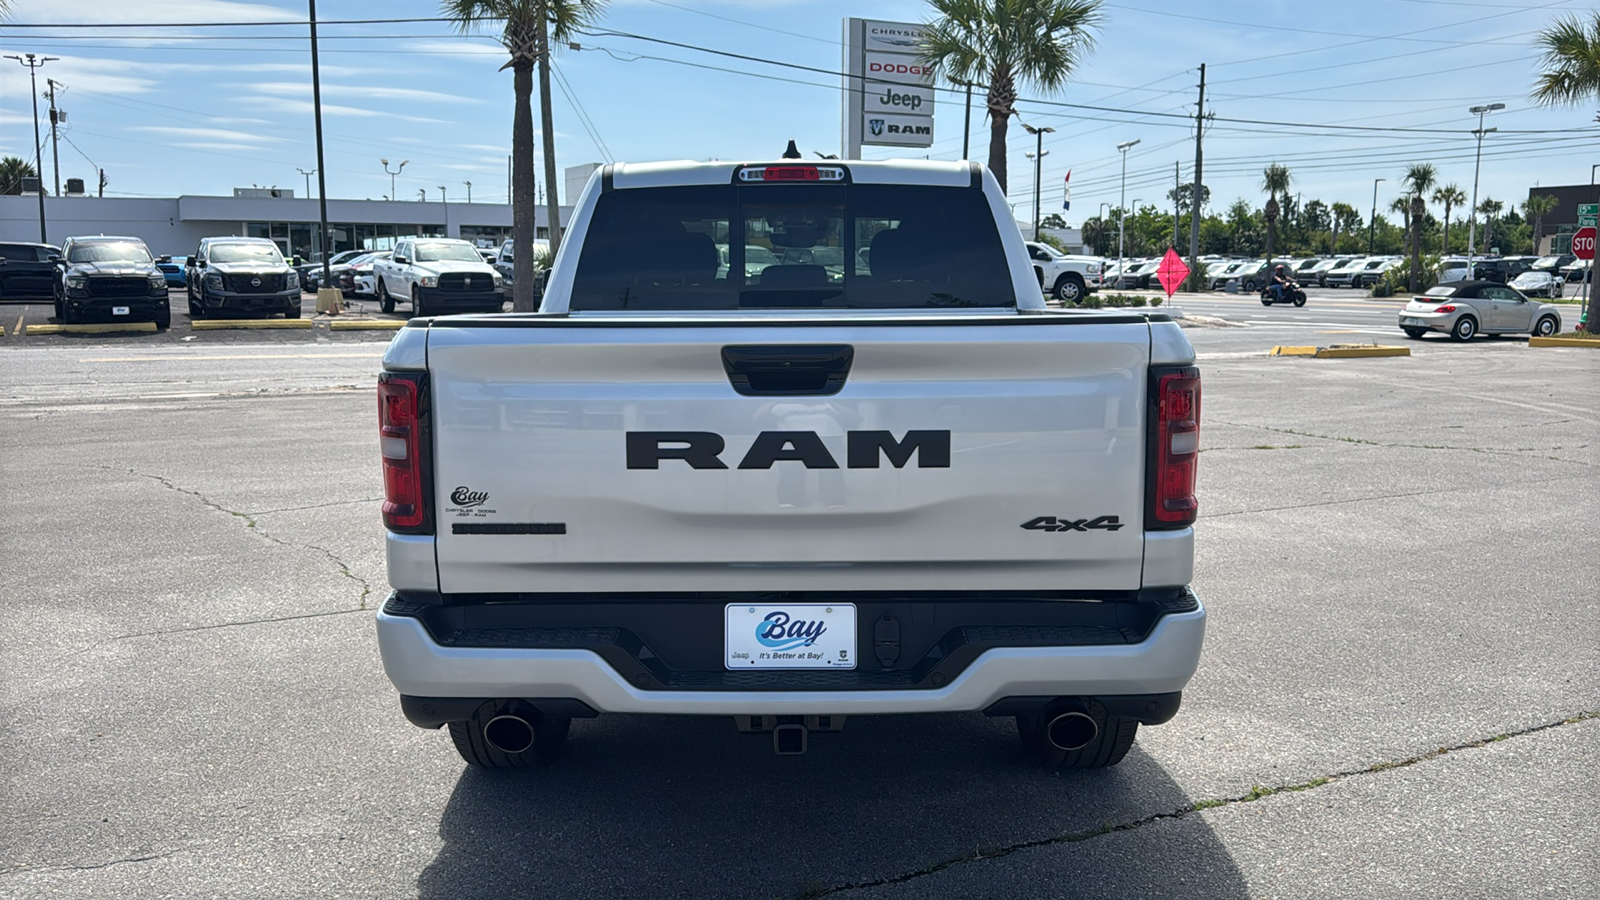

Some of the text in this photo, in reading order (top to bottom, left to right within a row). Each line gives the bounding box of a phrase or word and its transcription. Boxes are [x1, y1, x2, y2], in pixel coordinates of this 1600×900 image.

[870, 63, 932, 76] DODGE
[880, 89, 922, 110] Jeep
[888, 124, 930, 135] RAM
[626, 430, 951, 470] RAM
[455, 486, 490, 505] Bay
[1020, 516, 1125, 532] 4x4
[761, 611, 827, 647] Bay
[731, 652, 750, 660] Jeep
[772, 652, 796, 660] Better
[797, 652, 805, 660] at
[807, 652, 824, 661] Bay!
